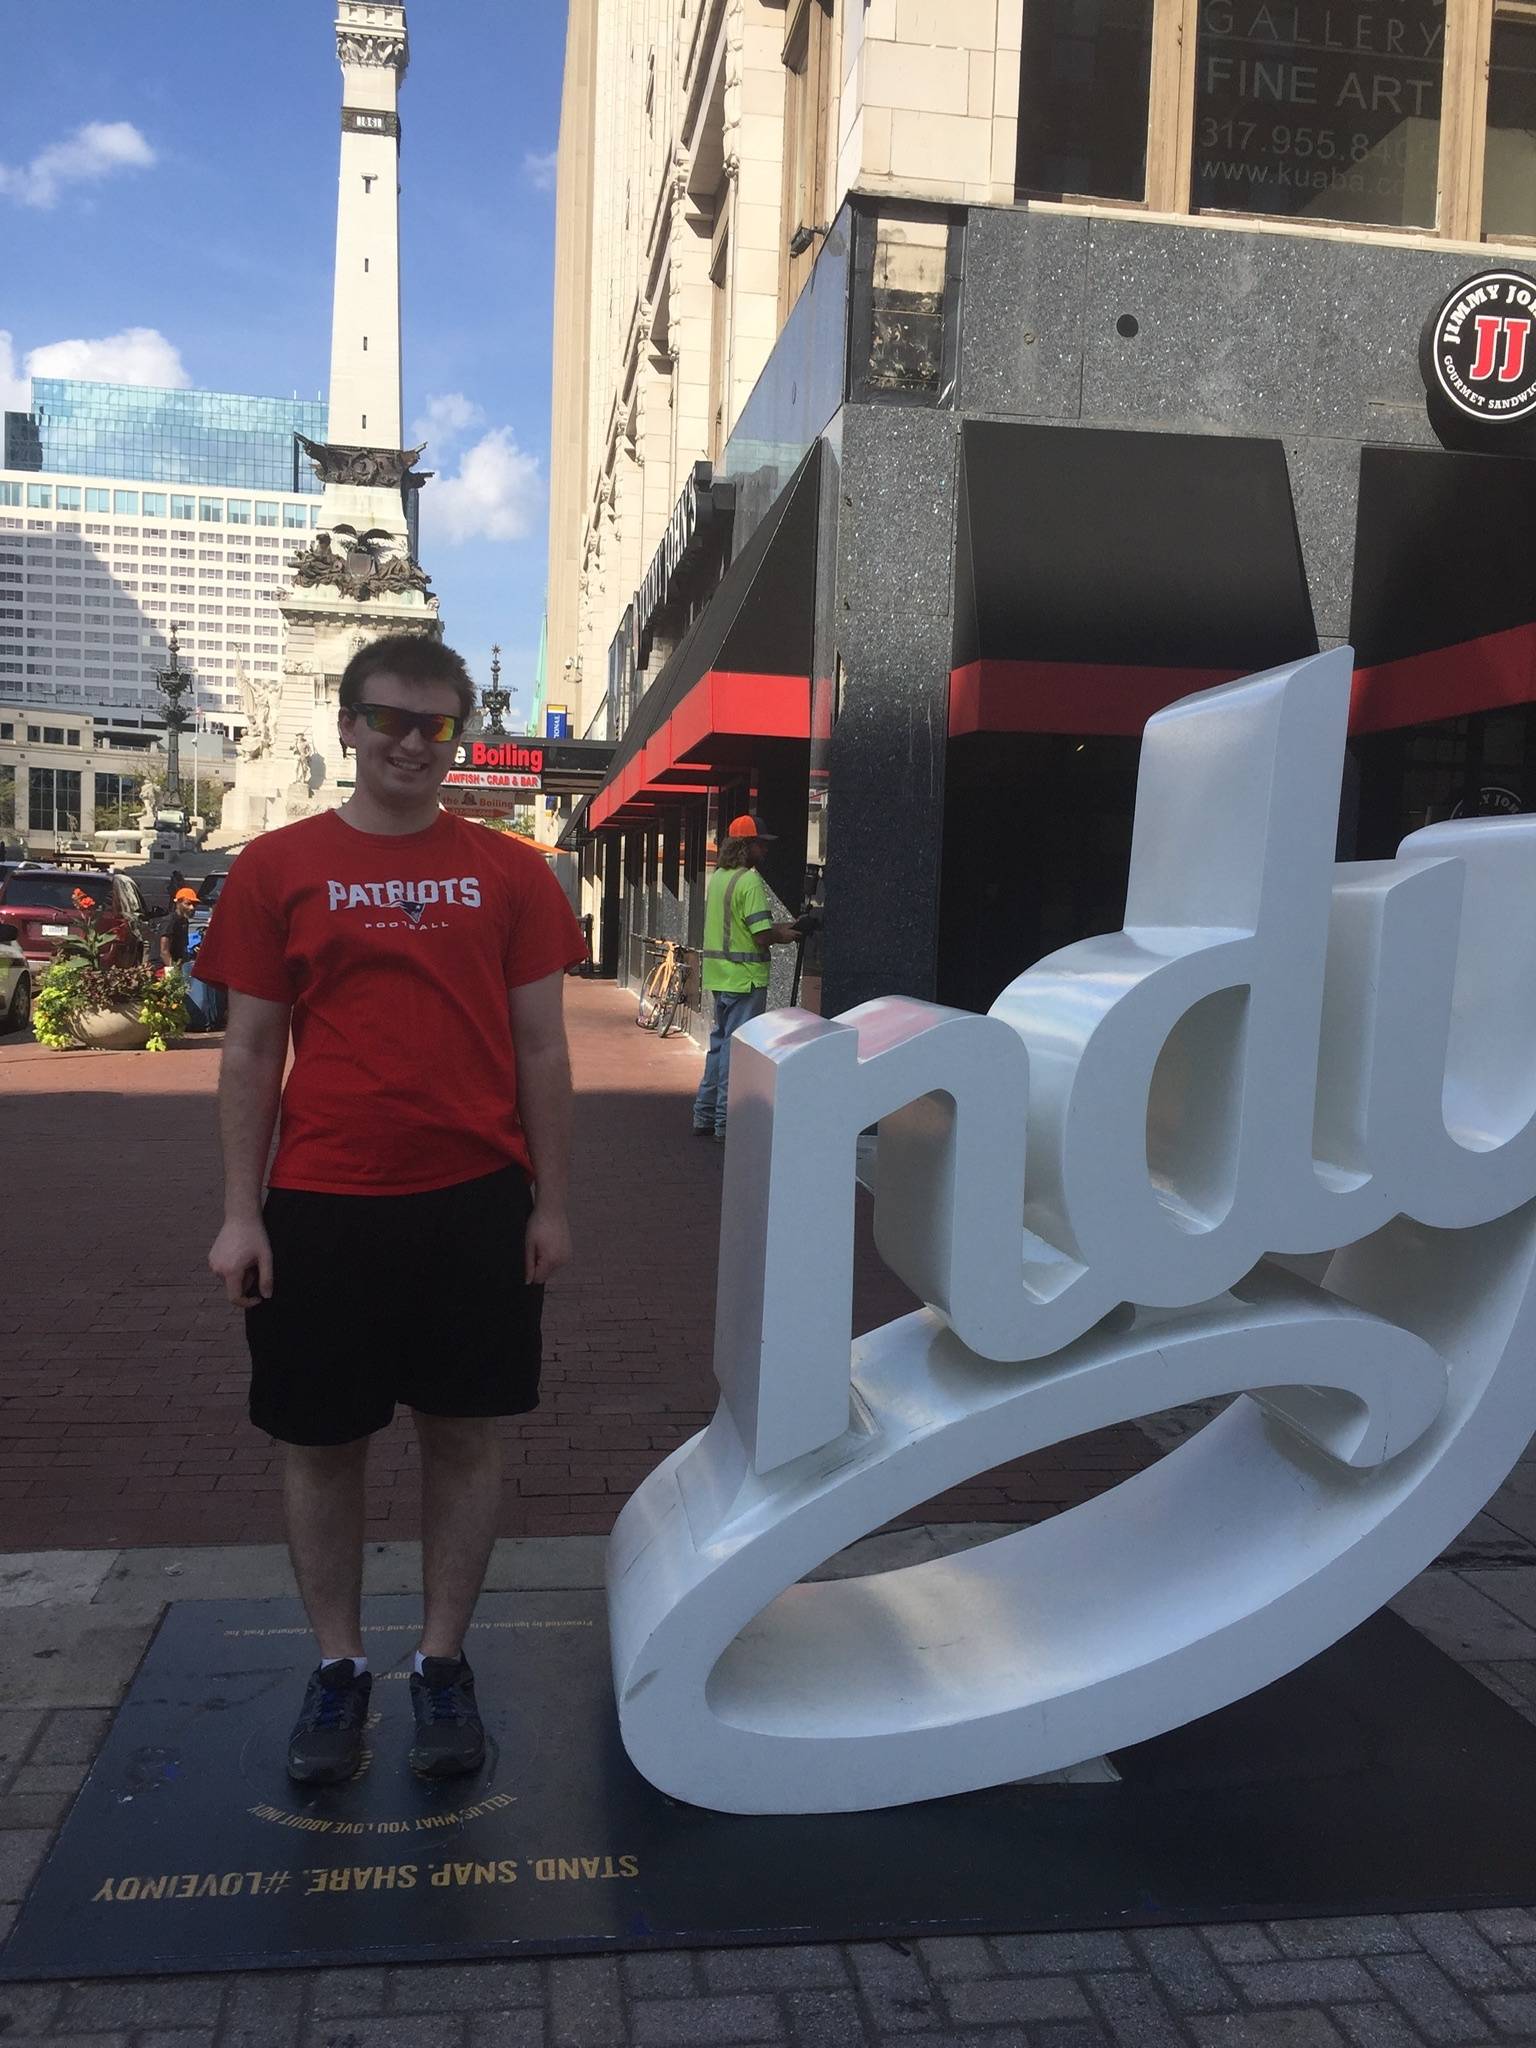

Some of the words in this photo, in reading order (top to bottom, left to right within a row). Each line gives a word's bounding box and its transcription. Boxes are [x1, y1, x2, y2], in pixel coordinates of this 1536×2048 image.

[1204, 0, 1443, 57] GALLERY
[1206, 57, 1319, 105] FINE
[1336, 72, 1434, 116] ART
[1443, 284, 1500, 344] JIMMY
[1469, 315, 1531, 383] JJ
[1444, 355, 1486, 407] GOURMET
[471, 741, 543, 773] Boiling
[445, 773, 480, 786] AWFISH
[487, 775, 510, 787] CRAB
[512, 776, 519, 786] &
[520, 776, 538, 788] BAR
[480, 799, 513, 810] Boiling
[327, 877, 481, 911] PATRIOTS
[460, 1805, 481, 1819] US
[479, 1792, 516, 1811] TELL
[279, 1813, 333, 1833] ABOUT
[377, 1820, 410, 1834] YOU
[414, 1812, 459, 1831] WHAT
[302, 1864, 418, 1896] SHARE.
[427, 1860, 518, 1887] SNAP.
[526, 1855, 640, 1881] STAND.
